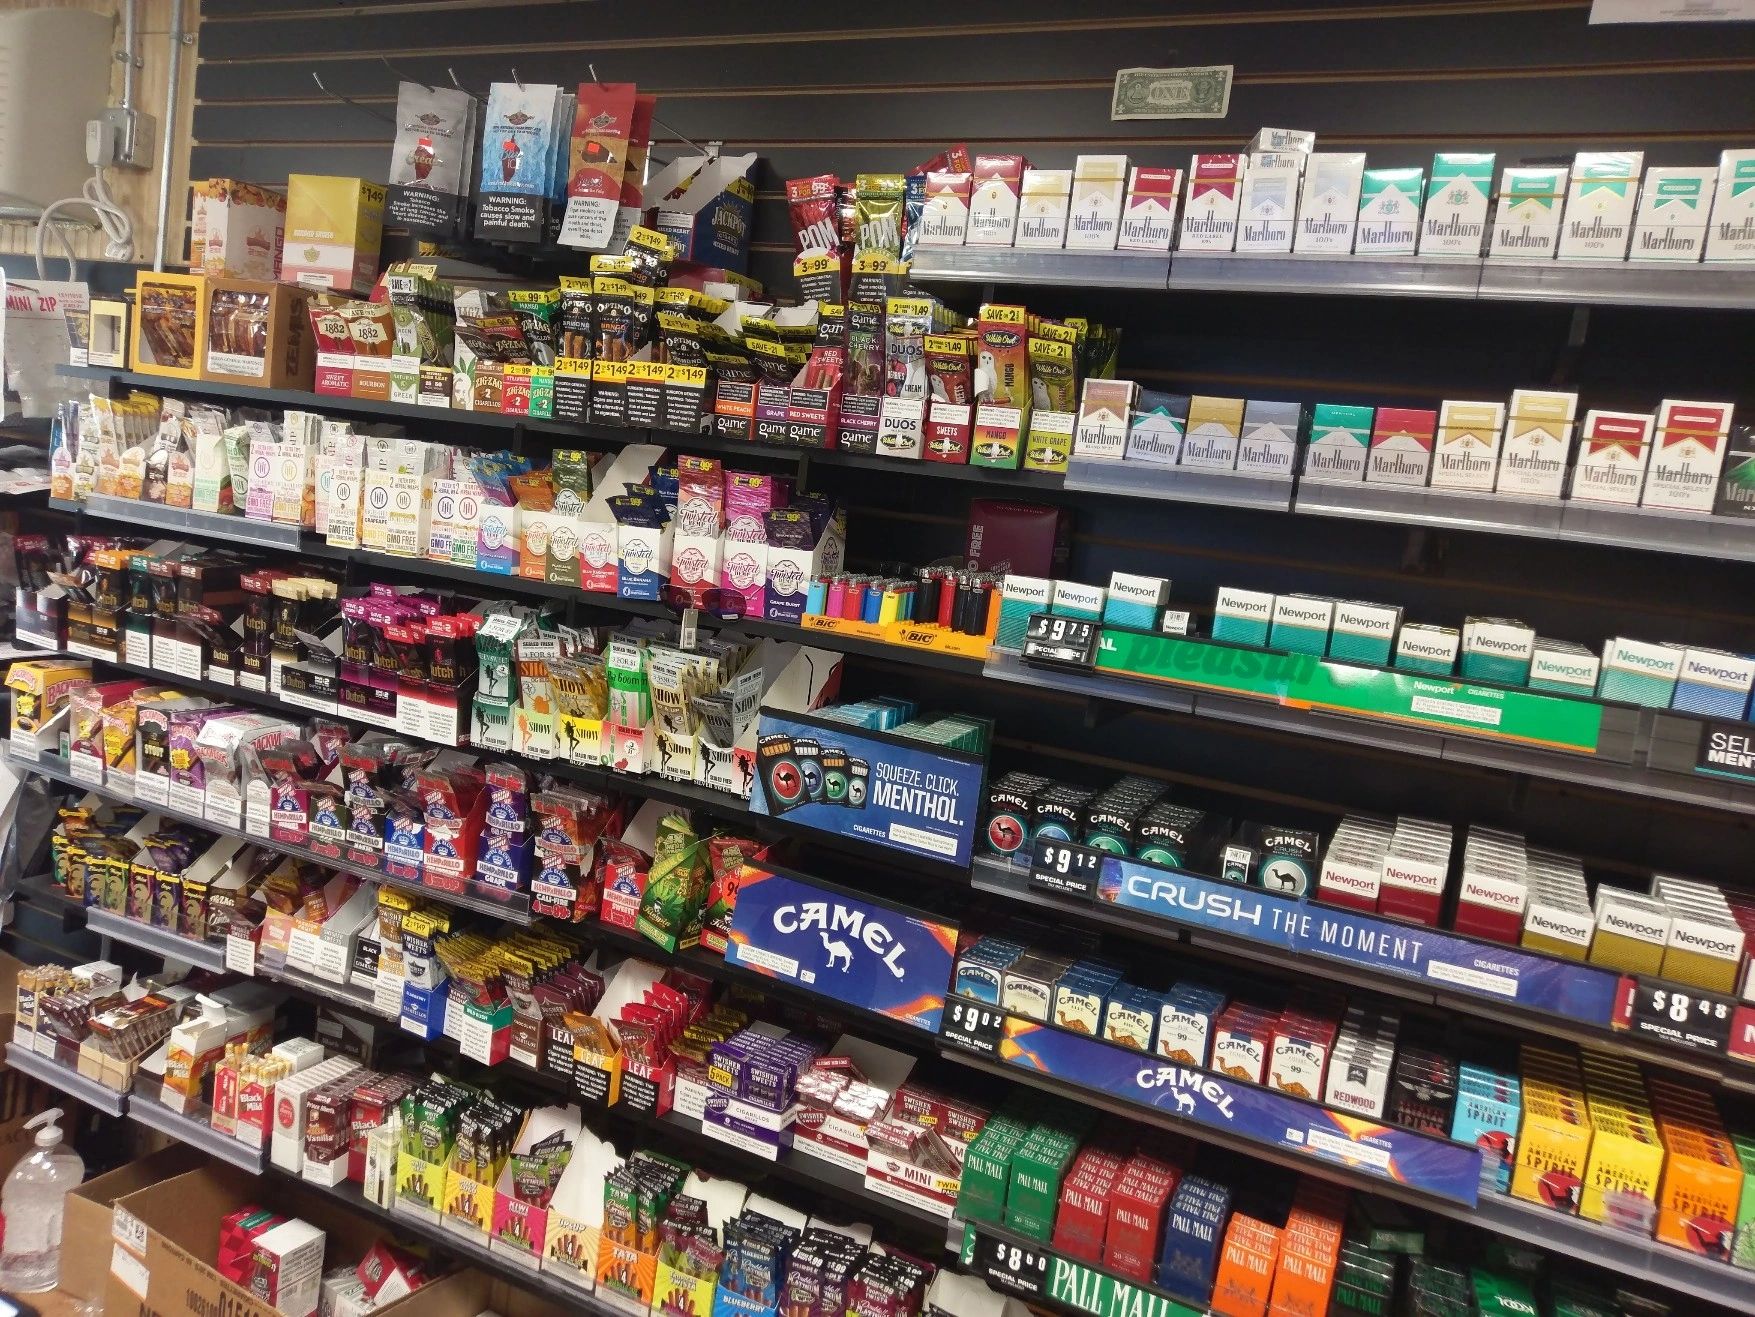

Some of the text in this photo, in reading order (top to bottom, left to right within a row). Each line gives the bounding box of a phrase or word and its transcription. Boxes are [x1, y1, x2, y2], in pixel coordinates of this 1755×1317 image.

[482, 204, 509, 212] Tobacco
[489, 196, 526, 205] WARNING:
[921, 214, 963, 239] Marlboro
[972, 208, 1011, 230] Marlboro
[1073, 211, 1113, 232] Marlboro
[1183, 210, 1234, 233] Marlboro
[1304, 211, 1348, 235] Marlboro
[1426, 213, 1480, 237] Marlboro
[1571, 216, 1622, 239] Marlboro
[799, 218, 839, 250] POM
[861, 217, 898, 248] POM
[1021, 218, 1060, 239] Marlboro
[1124, 218, 1169, 240] Marlboro
[1243, 220, 1286, 242] Marlboro
[1361, 222, 1413, 244] Marlboro
[1499, 226, 1549, 248] Marlboro
[1640, 228, 1694, 251] Marlboro
[38, 298, 57, 312] ZIP
[324, 323, 345, 333] 1882
[358, 329, 378, 339] 1882
[891, 344, 923, 356] DUOS
[321, 379, 349, 388] AROMATIC
[359, 381, 385, 389] BOURBON
[733, 405, 751, 413] PEACH
[766, 410, 785, 418] GRAPE
[790, 411, 825, 421] RED SWEETS
[717, 417, 746, 434] game
[841, 417, 877, 427] BLACK CHERRY
[884, 419, 916, 431] DUOS
[937, 426, 958, 436] SWEETS
[790, 426, 820, 442] game
[841, 432, 872, 448] game
[680, 509, 717, 526] Twisted
[328, 525, 354, 536] GMO FREE
[387, 534, 416, 546] GMO FREE
[1006, 582, 1045, 598] Newport
[1057, 589, 1099, 606] Newport
[1113, 581, 1156, 599] Newport
[1221, 598, 1268, 614] Newport
[1279, 608, 1326, 622] Newport
[1340, 612, 1390, 631] Newport
[1402, 640, 1451, 658] Newport
[1476, 635, 1527, 653] Newport
[1537, 660, 1592, 678] Newport
[1617, 649, 1674, 671] Newport
[1688, 660, 1748, 682] Newport
[653, 687, 681, 704] SHOW
[1414, 681, 1454, 696] Newport
[1468, 688, 1504, 700] CIGARETTES
[485, 714, 508, 725] SHOW
[529, 721, 551, 734] SHOW
[576, 728, 600, 740] SHOW
[669, 743, 692, 755] SHOW
[876, 762, 959, 796] SQUEEZE. CLICK.
[873, 780, 964, 826] MENTHOL.
[991, 793, 1028, 811] CAMEL
[1037, 803, 1076, 821] CAMEL
[853, 824, 886, 838] CIGARETTES
[1091, 814, 1131, 832] CAMEL
[1142, 825, 1184, 844] CAMEL
[1265, 836, 1312, 852] CAMEL
[1035, 873, 1065, 887] SPECIAL
[1066, 879, 1087, 891] PRICE
[1326, 870, 1375, 892] Newport
[1386, 867, 1437, 887] Newport
[1466, 883, 1519, 905] Newport
[1127, 874, 1423, 965] CRUSH THE MOMENT
[773, 902, 906, 979] CAMEL
[959, 967, 997, 985] CAMEL
[1473, 958, 1520, 976] CIGARETTES
[1007, 981, 1046, 1001] CAMEL
[1058, 995, 1098, 1016] CAMEL
[1109, 1011, 1149, 1033] CAMEL
[1162, 1013, 1205, 1036] CAMEL
[945, 1032, 972, 1046] SPECIAL
[973, 1039, 993, 1050] PRICE
[1177, 1032, 1187, 1041] 99
[1640, 1021, 1717, 1048] SPECIAL PRICE
[581, 1050, 605, 1069] LEAF
[1218, 1040, 1261, 1063] CAMEL
[1276, 1045, 1321, 1068] CAMEL
[628, 1062, 652, 1079] LEAF
[713, 1054, 741, 1070] SWISHER
[714, 1061, 739, 1076] SWEETS
[750, 1067, 778, 1082] SWISHER
[752, 1075, 777, 1088] SWEETS
[240, 1092, 262, 1104] Black
[1136, 1068, 1235, 1119] CAMEL
[1333, 1089, 1376, 1109] REDWOOD
[246, 1101, 263, 1112] Mild
[903, 1096, 932, 1111] SWISHER
[905, 1103, 930, 1115] SWEETS
[736, 1107, 770, 1123] CIGARILLOS
[948, 1111, 976, 1126] SWISHER
[1467, 1108, 1506, 1128] SPIRIT
[352, 1119, 378, 1131] Black
[828, 1124, 864, 1140] CIGARILLOS
[948, 1118, 975, 1131] SWEETS
[307, 1134, 333, 1142] Vanilla
[1360, 1134, 1392, 1149] CIGARETTES
[1528, 1147, 1577, 1166] AMERICAN
[968, 1154, 1002, 1180] PALL MALL
[905, 1167, 932, 1186] MINI
[1017, 1171, 1048, 1195] PALL MALL
[1597, 1167, 1649, 1186] AMERICAN
[1065, 1188, 1103, 1216] PALL MALL
[1674, 1191, 1729, 1210] AMERICAN
[1117, 1207, 1149, 1231] PALL MALL
[1172, 1213, 1213, 1242] PALL MALL
[1226, 1246, 1268, 1276] PALL MALL
[1283, 1255, 1327, 1284] PALL MALL
[988, 1267, 1038, 1292] SPECIAL PRICE
[723, 1295, 765, 1312] BLUEBERRY
